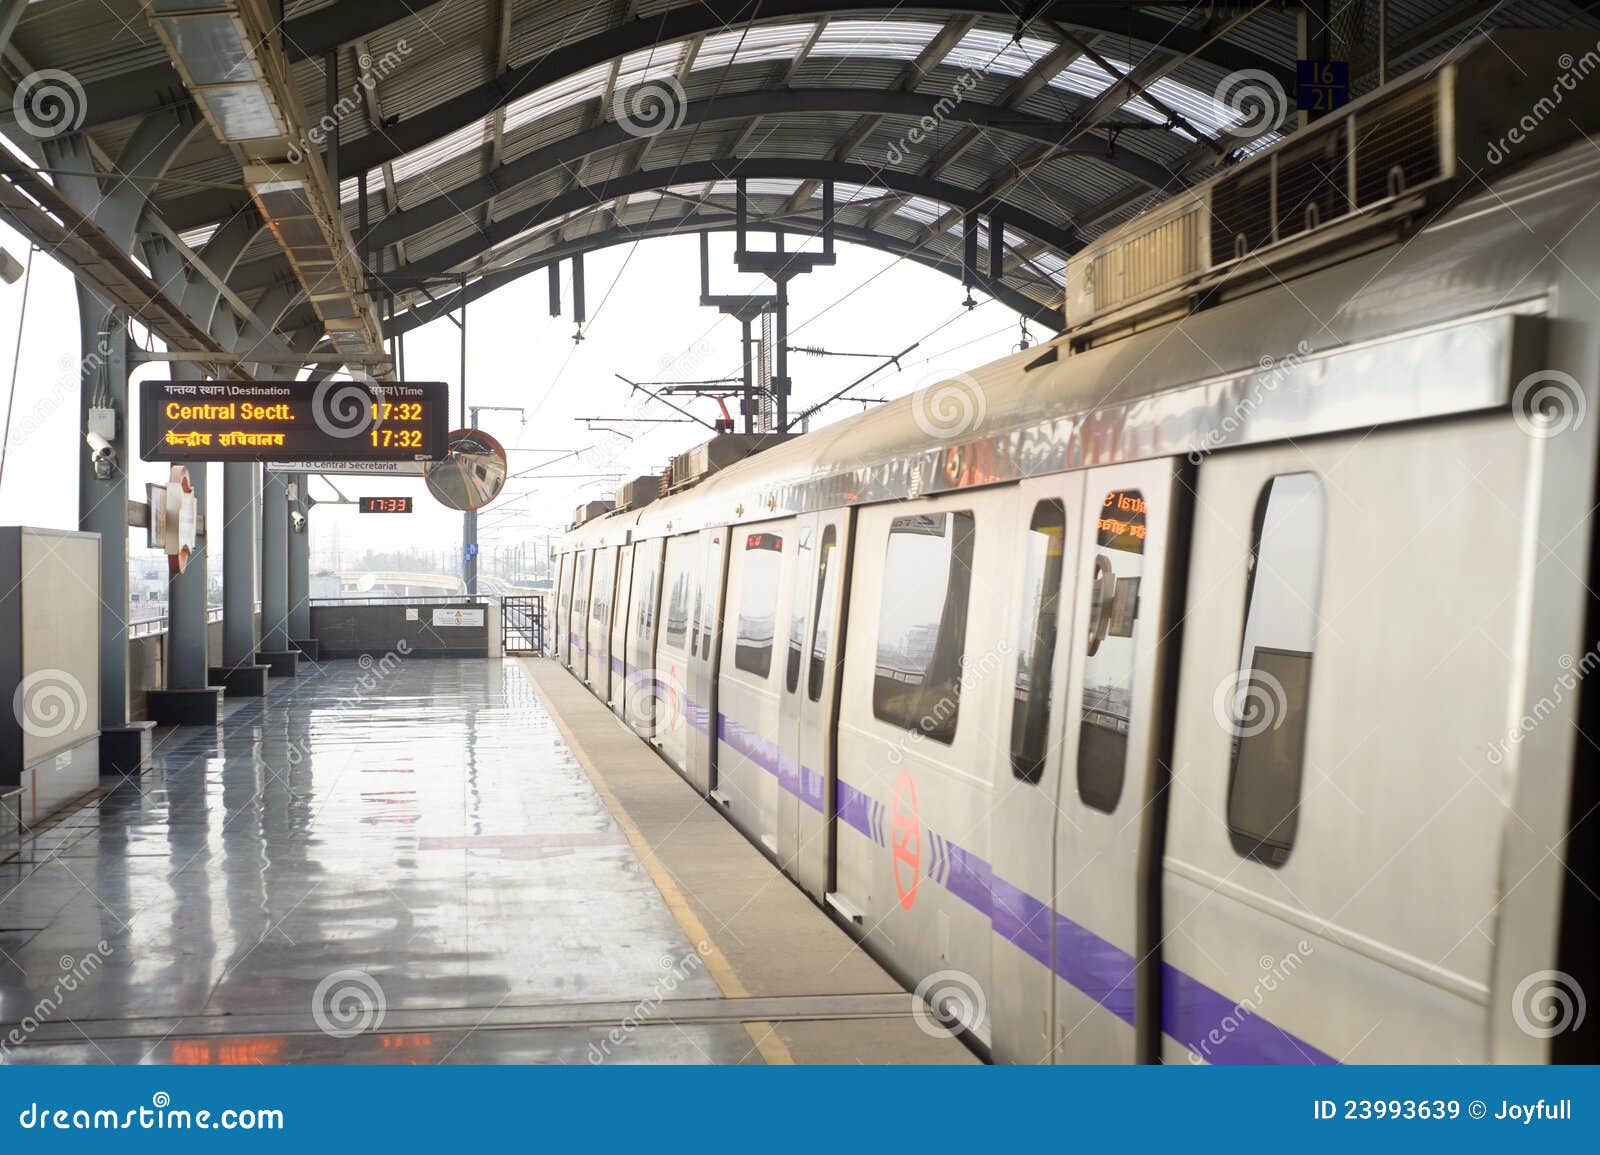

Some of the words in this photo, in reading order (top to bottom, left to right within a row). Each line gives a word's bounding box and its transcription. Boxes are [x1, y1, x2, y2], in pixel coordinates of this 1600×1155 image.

[1313, 62, 1335, 84] 16
[1311, 87, 1333, 111] 21
[166, 402, 236, 420] Central
[240, 402, 296, 420] Sectt.
[371, 403, 423, 421] 17:32
[371, 430, 423, 447] 17:32
[314, 461, 347, 469] Central
[348, 461, 398, 470] Secretariat
[369, 498, 407, 512] 17:33
